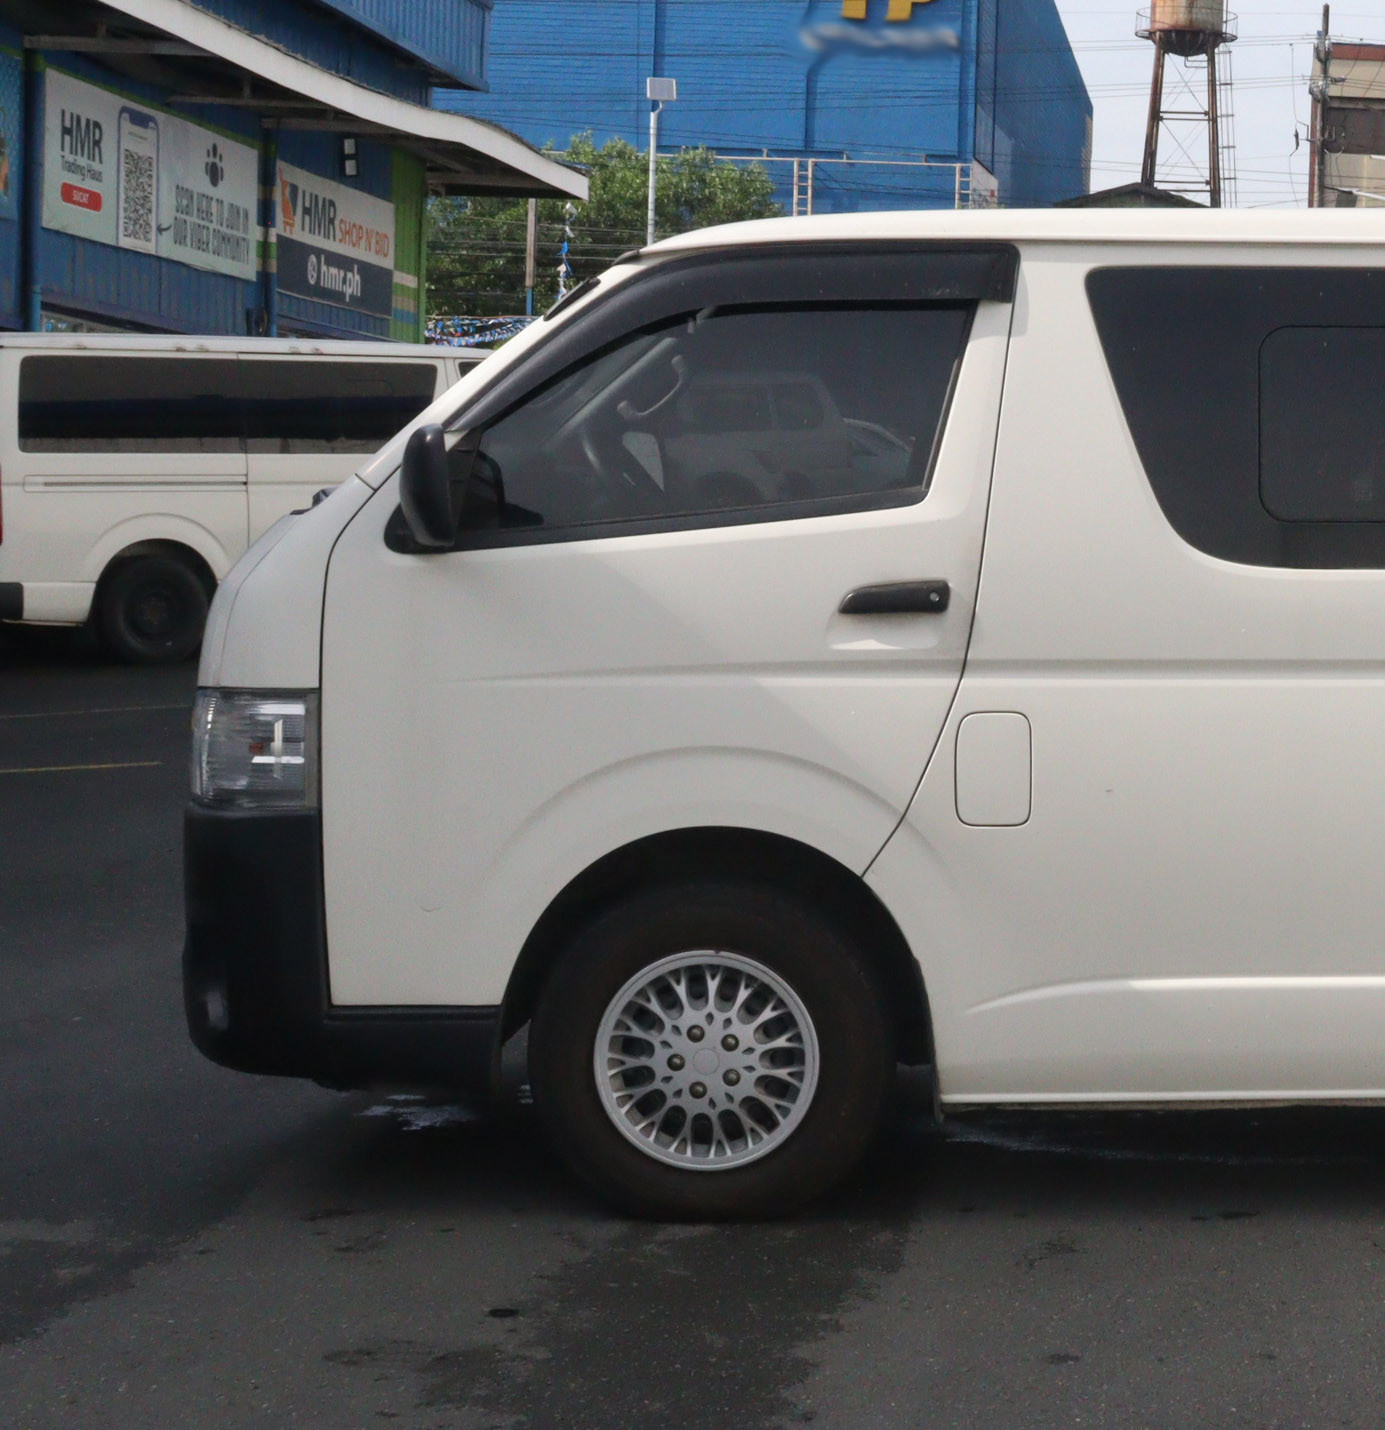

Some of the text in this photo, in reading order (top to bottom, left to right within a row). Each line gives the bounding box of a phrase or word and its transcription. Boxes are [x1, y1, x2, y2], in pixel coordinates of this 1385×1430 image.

[61, 109, 102, 164] HMR
[61, 155, 103, 183] Trading Haus
[176, 184, 249, 235] SCAN HERE TO JOIN IN
[301, 190, 336, 241] HMR
[173, 215, 249, 264] OUR VIBER COMMUNITY
[338, 218, 363, 248] SHOP
[375, 231, 390, 258] BID
[320, 254, 361, 302] hmr.ph
